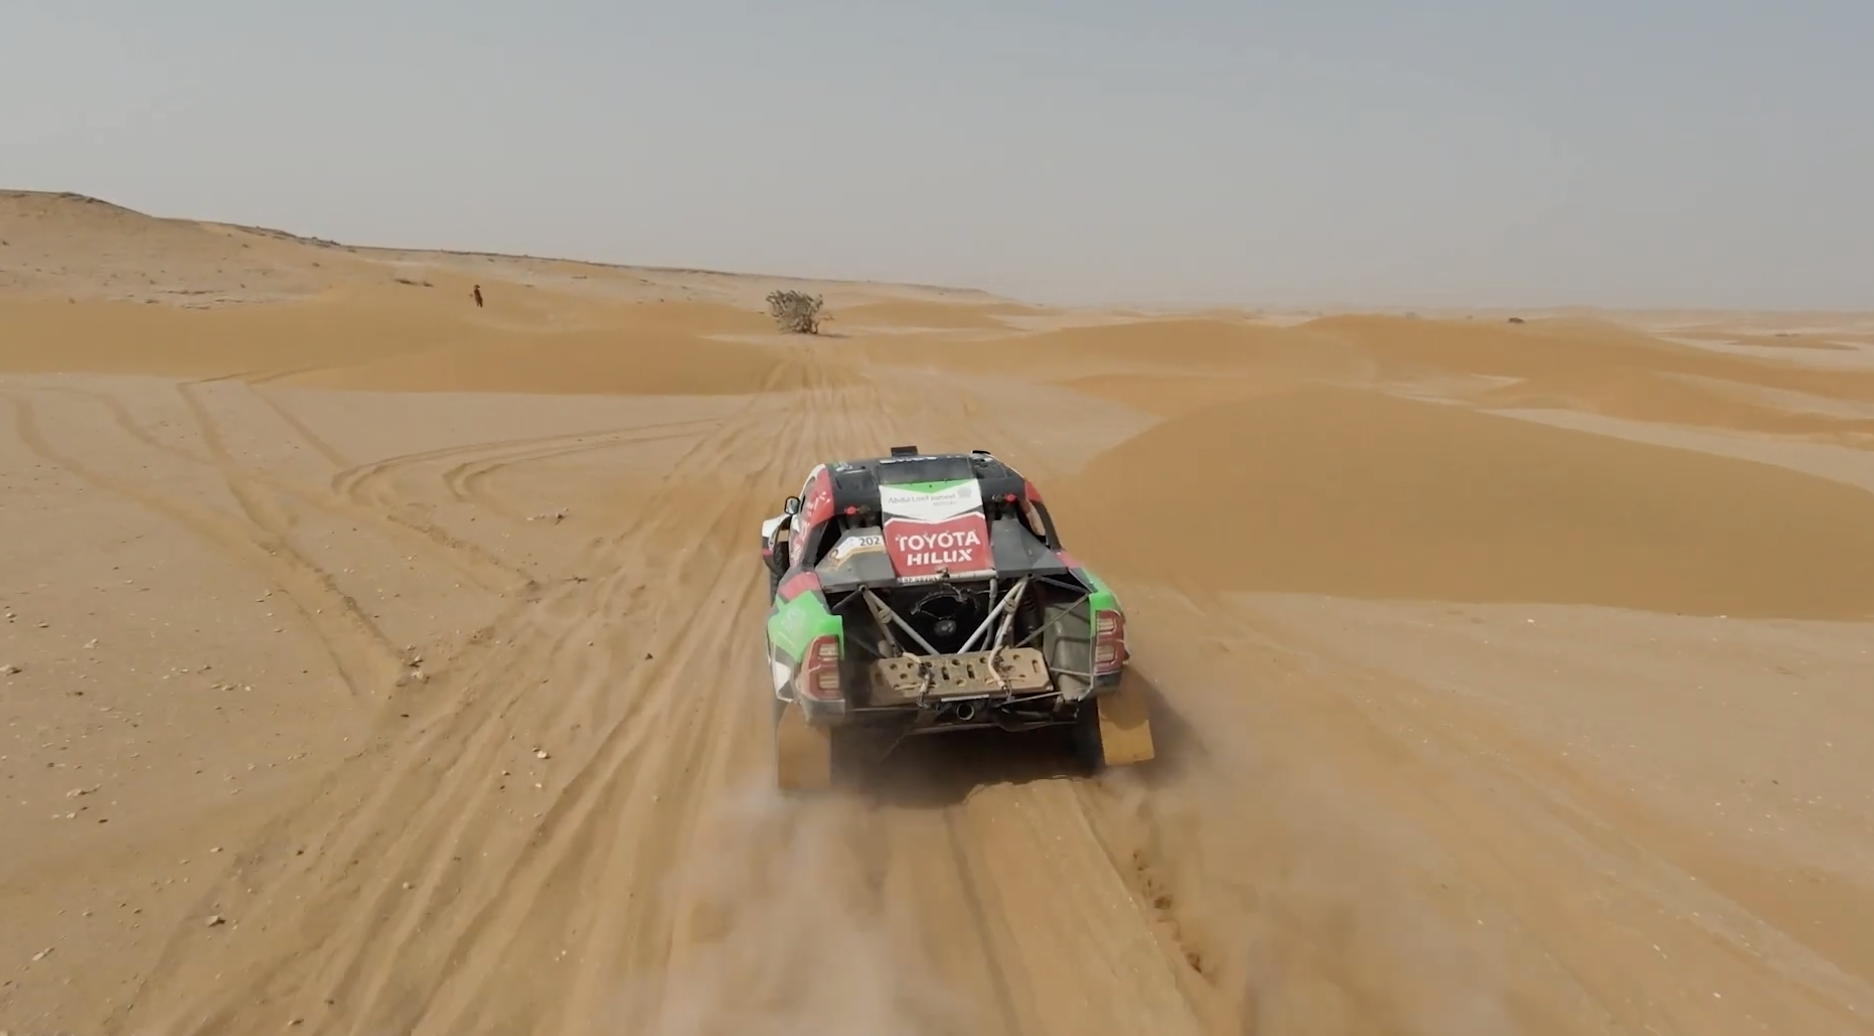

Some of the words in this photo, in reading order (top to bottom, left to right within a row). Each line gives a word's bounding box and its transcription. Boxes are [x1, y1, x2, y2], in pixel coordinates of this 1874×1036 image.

[859, 536, 881, 547] 202
[895, 530, 981, 552] TOYOTA
[907, 548, 973, 567] HILUX
